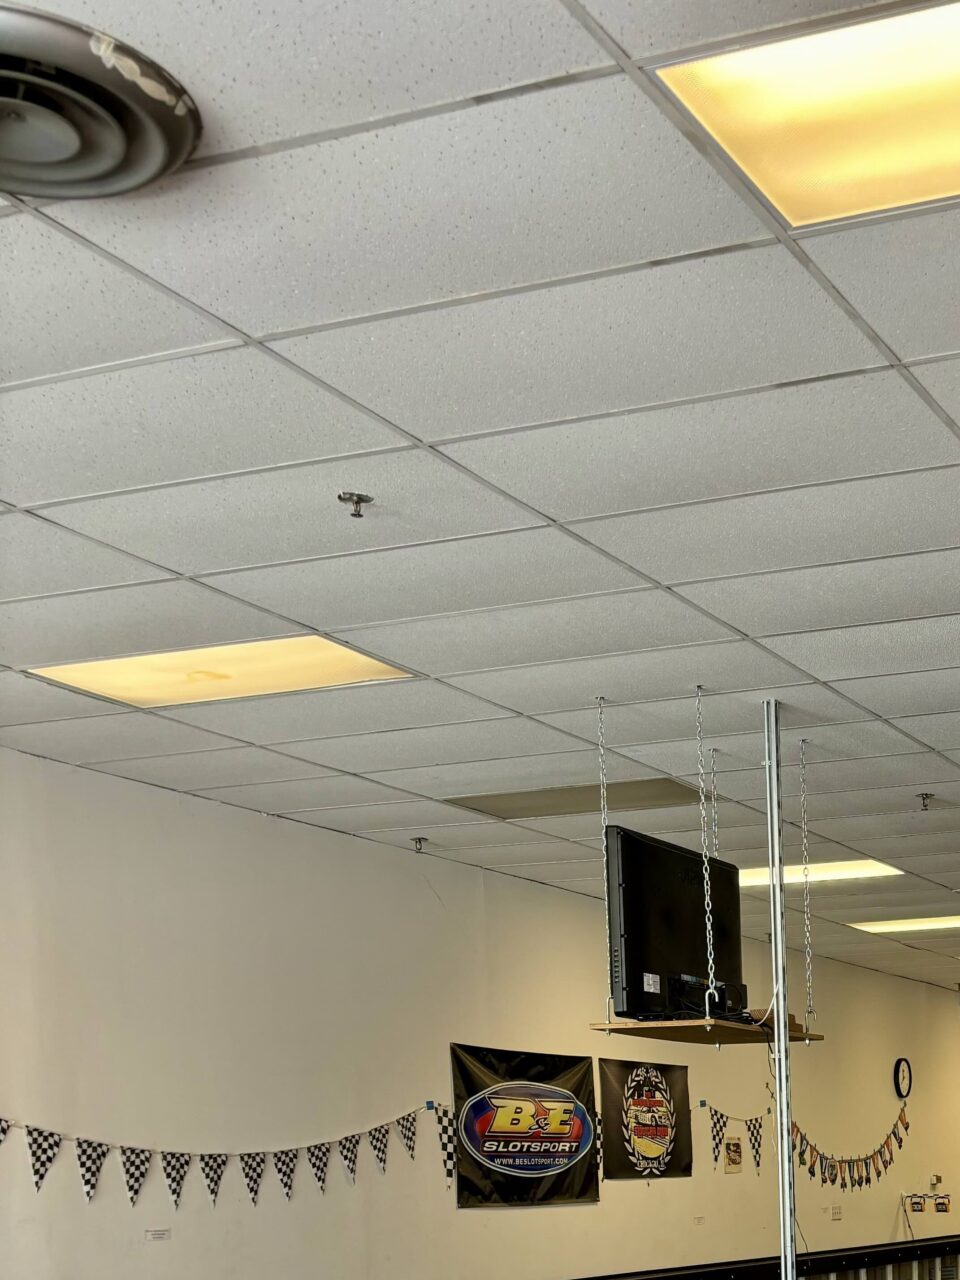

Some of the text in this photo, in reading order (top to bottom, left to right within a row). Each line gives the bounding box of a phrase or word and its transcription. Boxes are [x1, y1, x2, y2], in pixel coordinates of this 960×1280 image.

[486, 1095, 575, 1136] B&E
[483, 1141, 578, 1152] SLOTSPORT
[494, 1157, 569, 1166] WWW.BESLOTSPORT.COM
